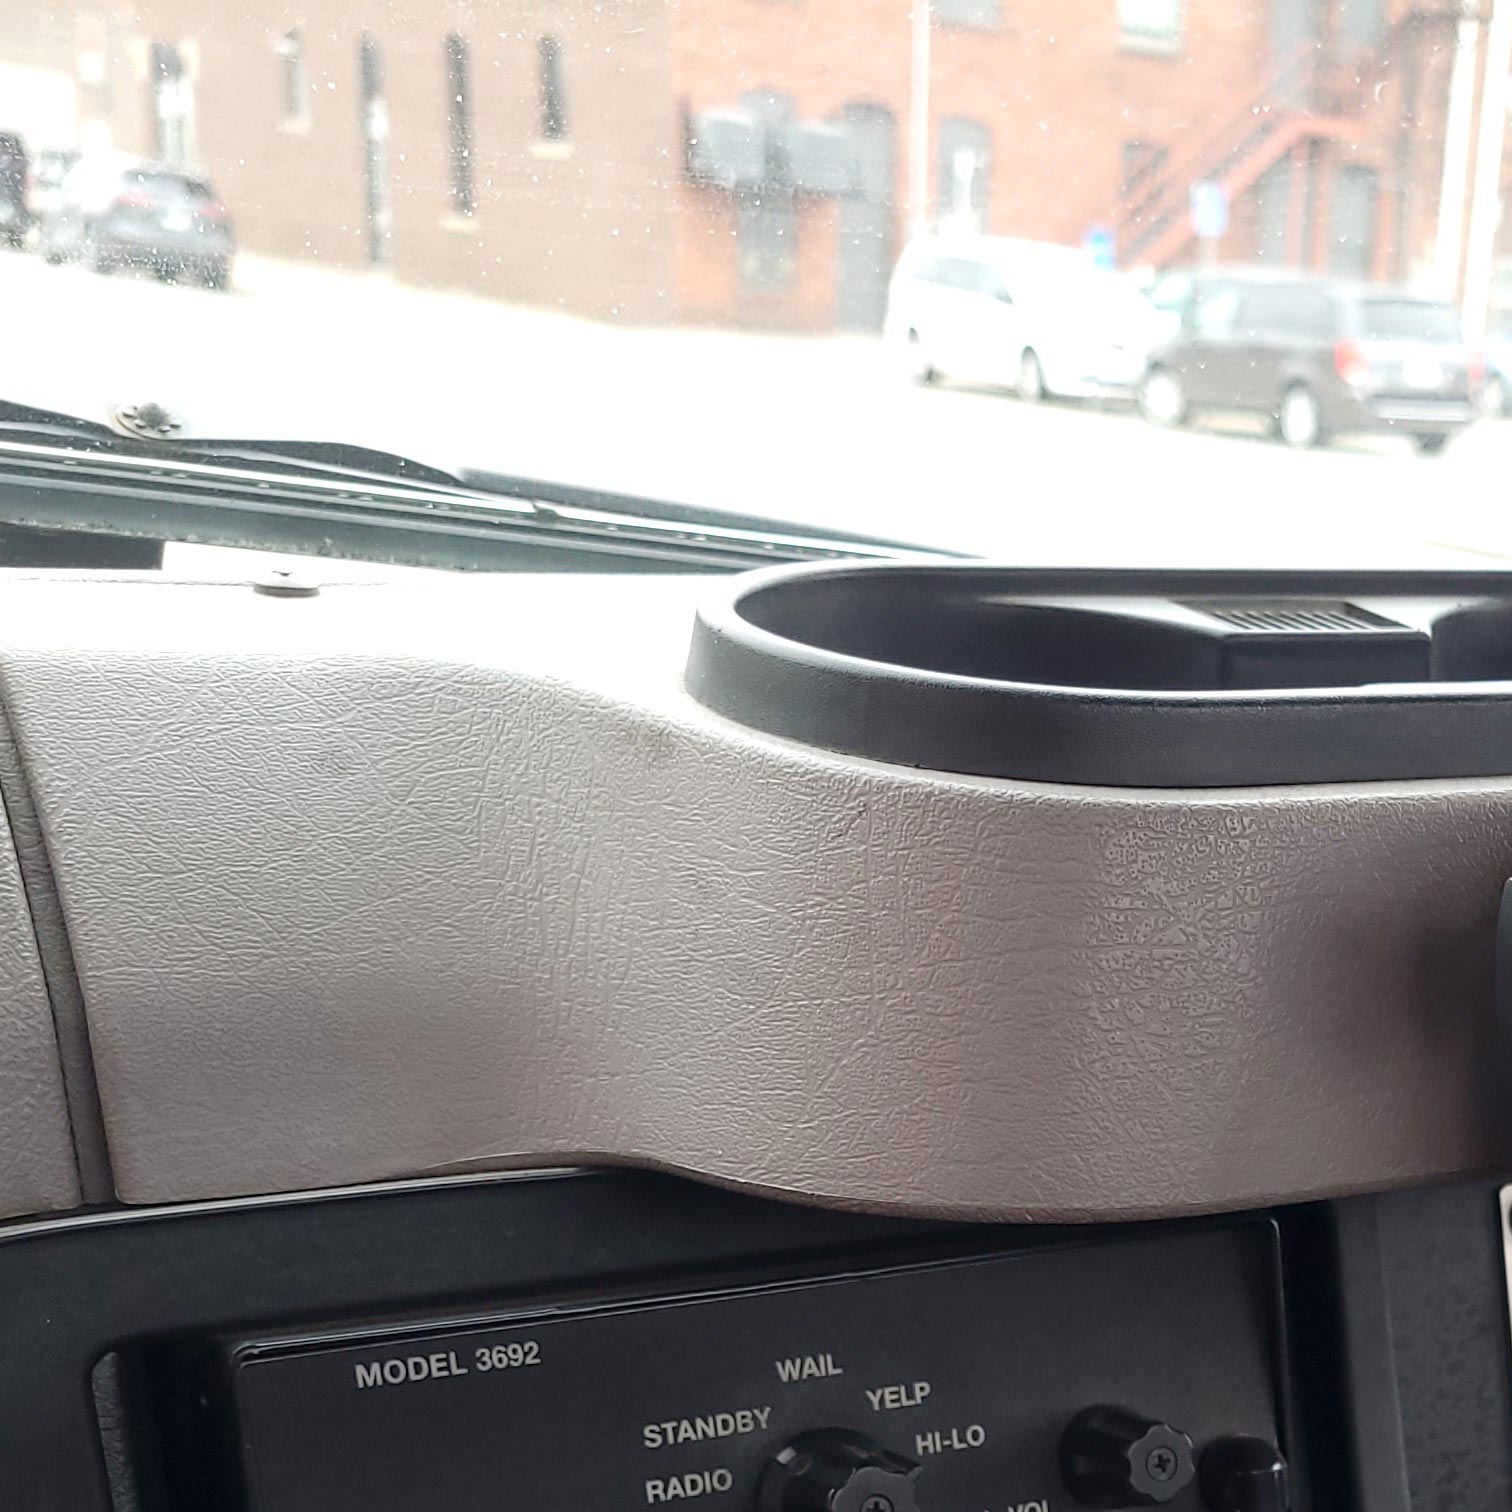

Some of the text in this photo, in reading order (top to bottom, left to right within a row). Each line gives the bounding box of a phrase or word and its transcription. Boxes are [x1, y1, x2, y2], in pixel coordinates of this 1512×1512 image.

[355, 1341, 541, 1388] MODEL 3692
[776, 1354, 842, 1382] WAIL
[867, 1382, 931, 1411] YELP
[643, 1407, 771, 1448] STANDBY
[915, 1425, 986, 1456] HI-LO
[645, 1469, 733, 1503] RADIO
